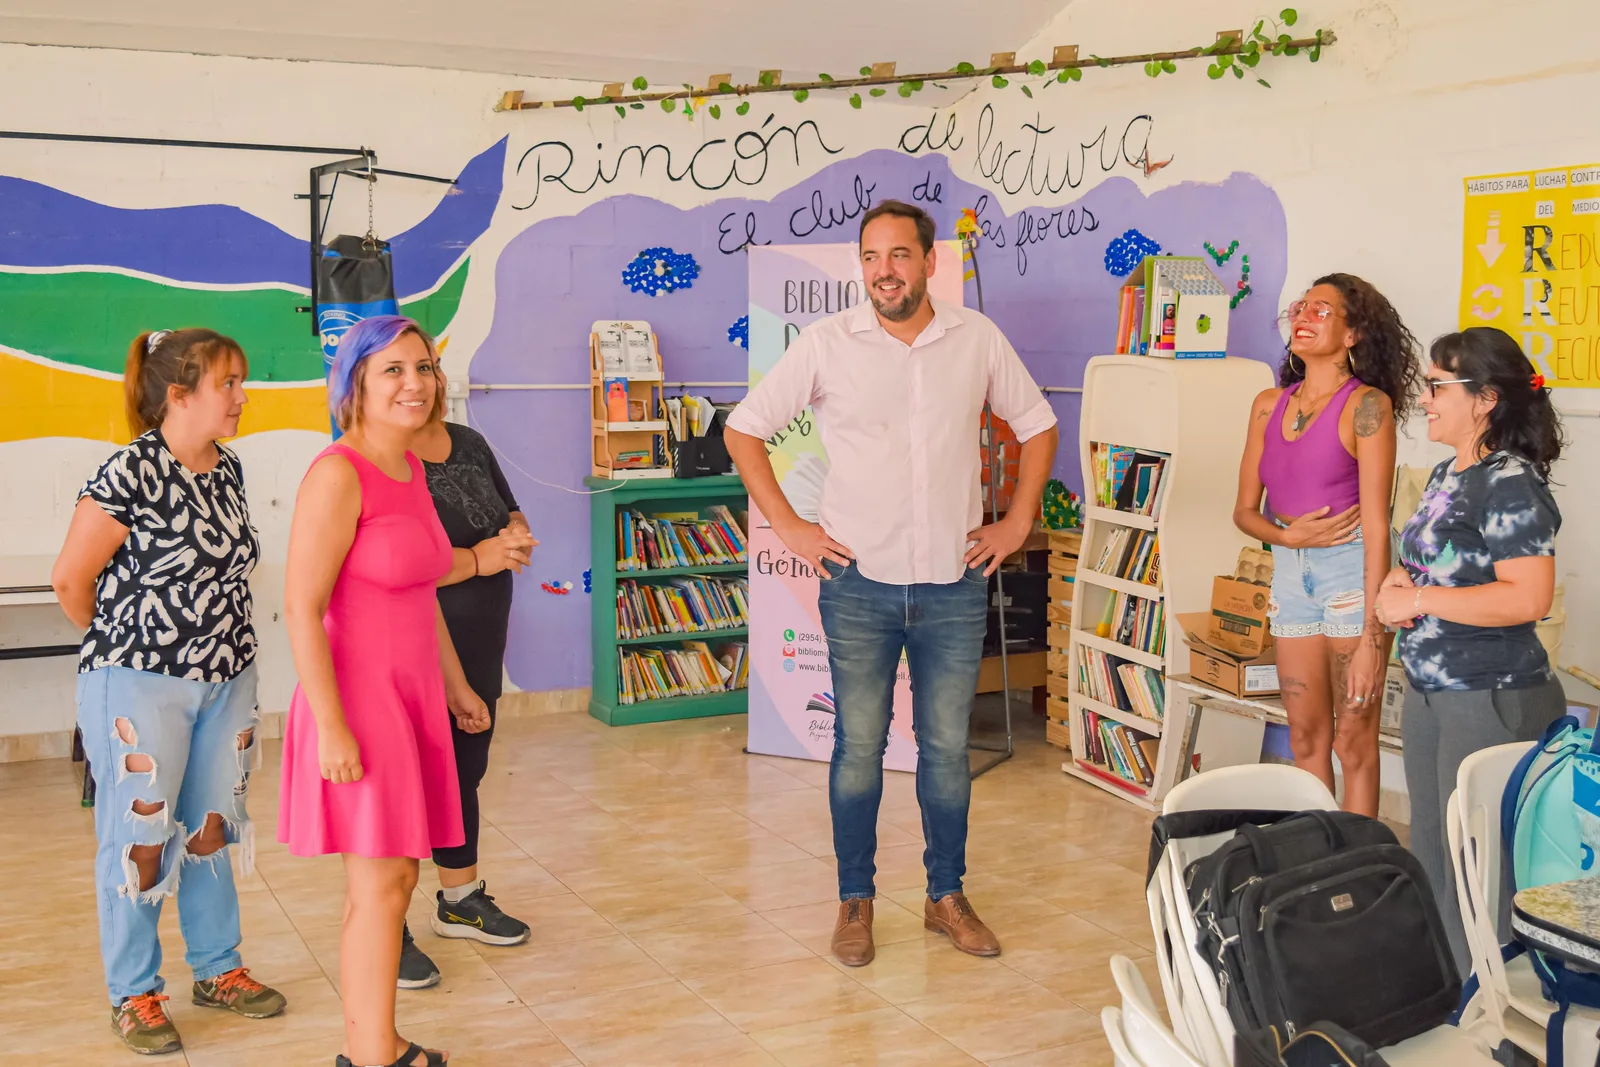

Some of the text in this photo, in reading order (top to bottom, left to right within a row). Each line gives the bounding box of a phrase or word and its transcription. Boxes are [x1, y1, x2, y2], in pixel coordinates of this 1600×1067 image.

[511, 103, 1174, 210] Rincón de lectura
[1467, 180, 1504, 193] HÁBITOS
[1506, 179, 1529, 189] PARA
[1534, 174, 1567, 187] LUCHAR
[1538, 201, 1600, 216] DEL MEDIO
[718, 171, 1100, 277] El club de las flores
[784, 279, 868, 314] BIBLIO
[798, 632, 821, 644] (2954)
